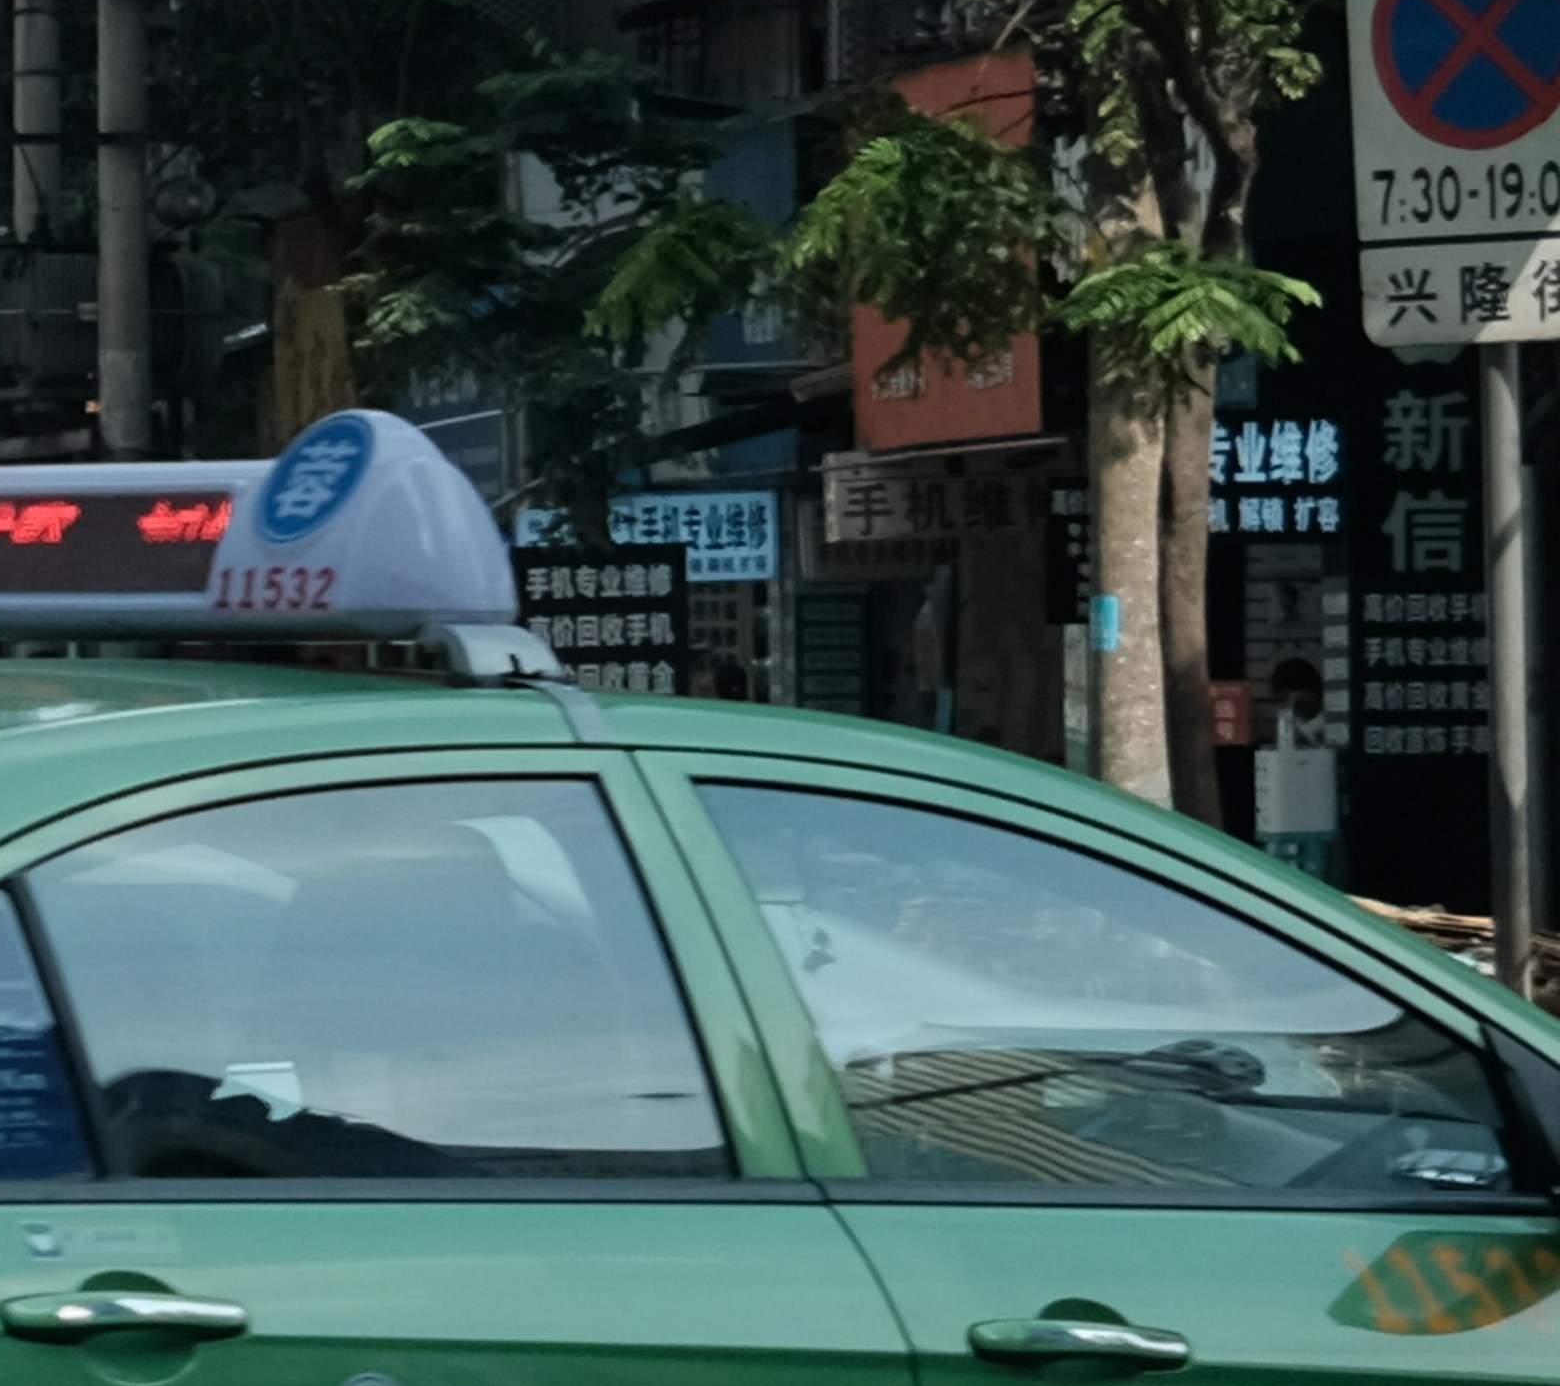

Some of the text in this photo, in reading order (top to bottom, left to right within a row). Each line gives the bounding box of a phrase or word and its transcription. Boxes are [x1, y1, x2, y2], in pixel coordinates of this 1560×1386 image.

[213, 564, 335, 610] 11532
[526, 564, 672, 600] 手机专业维修
